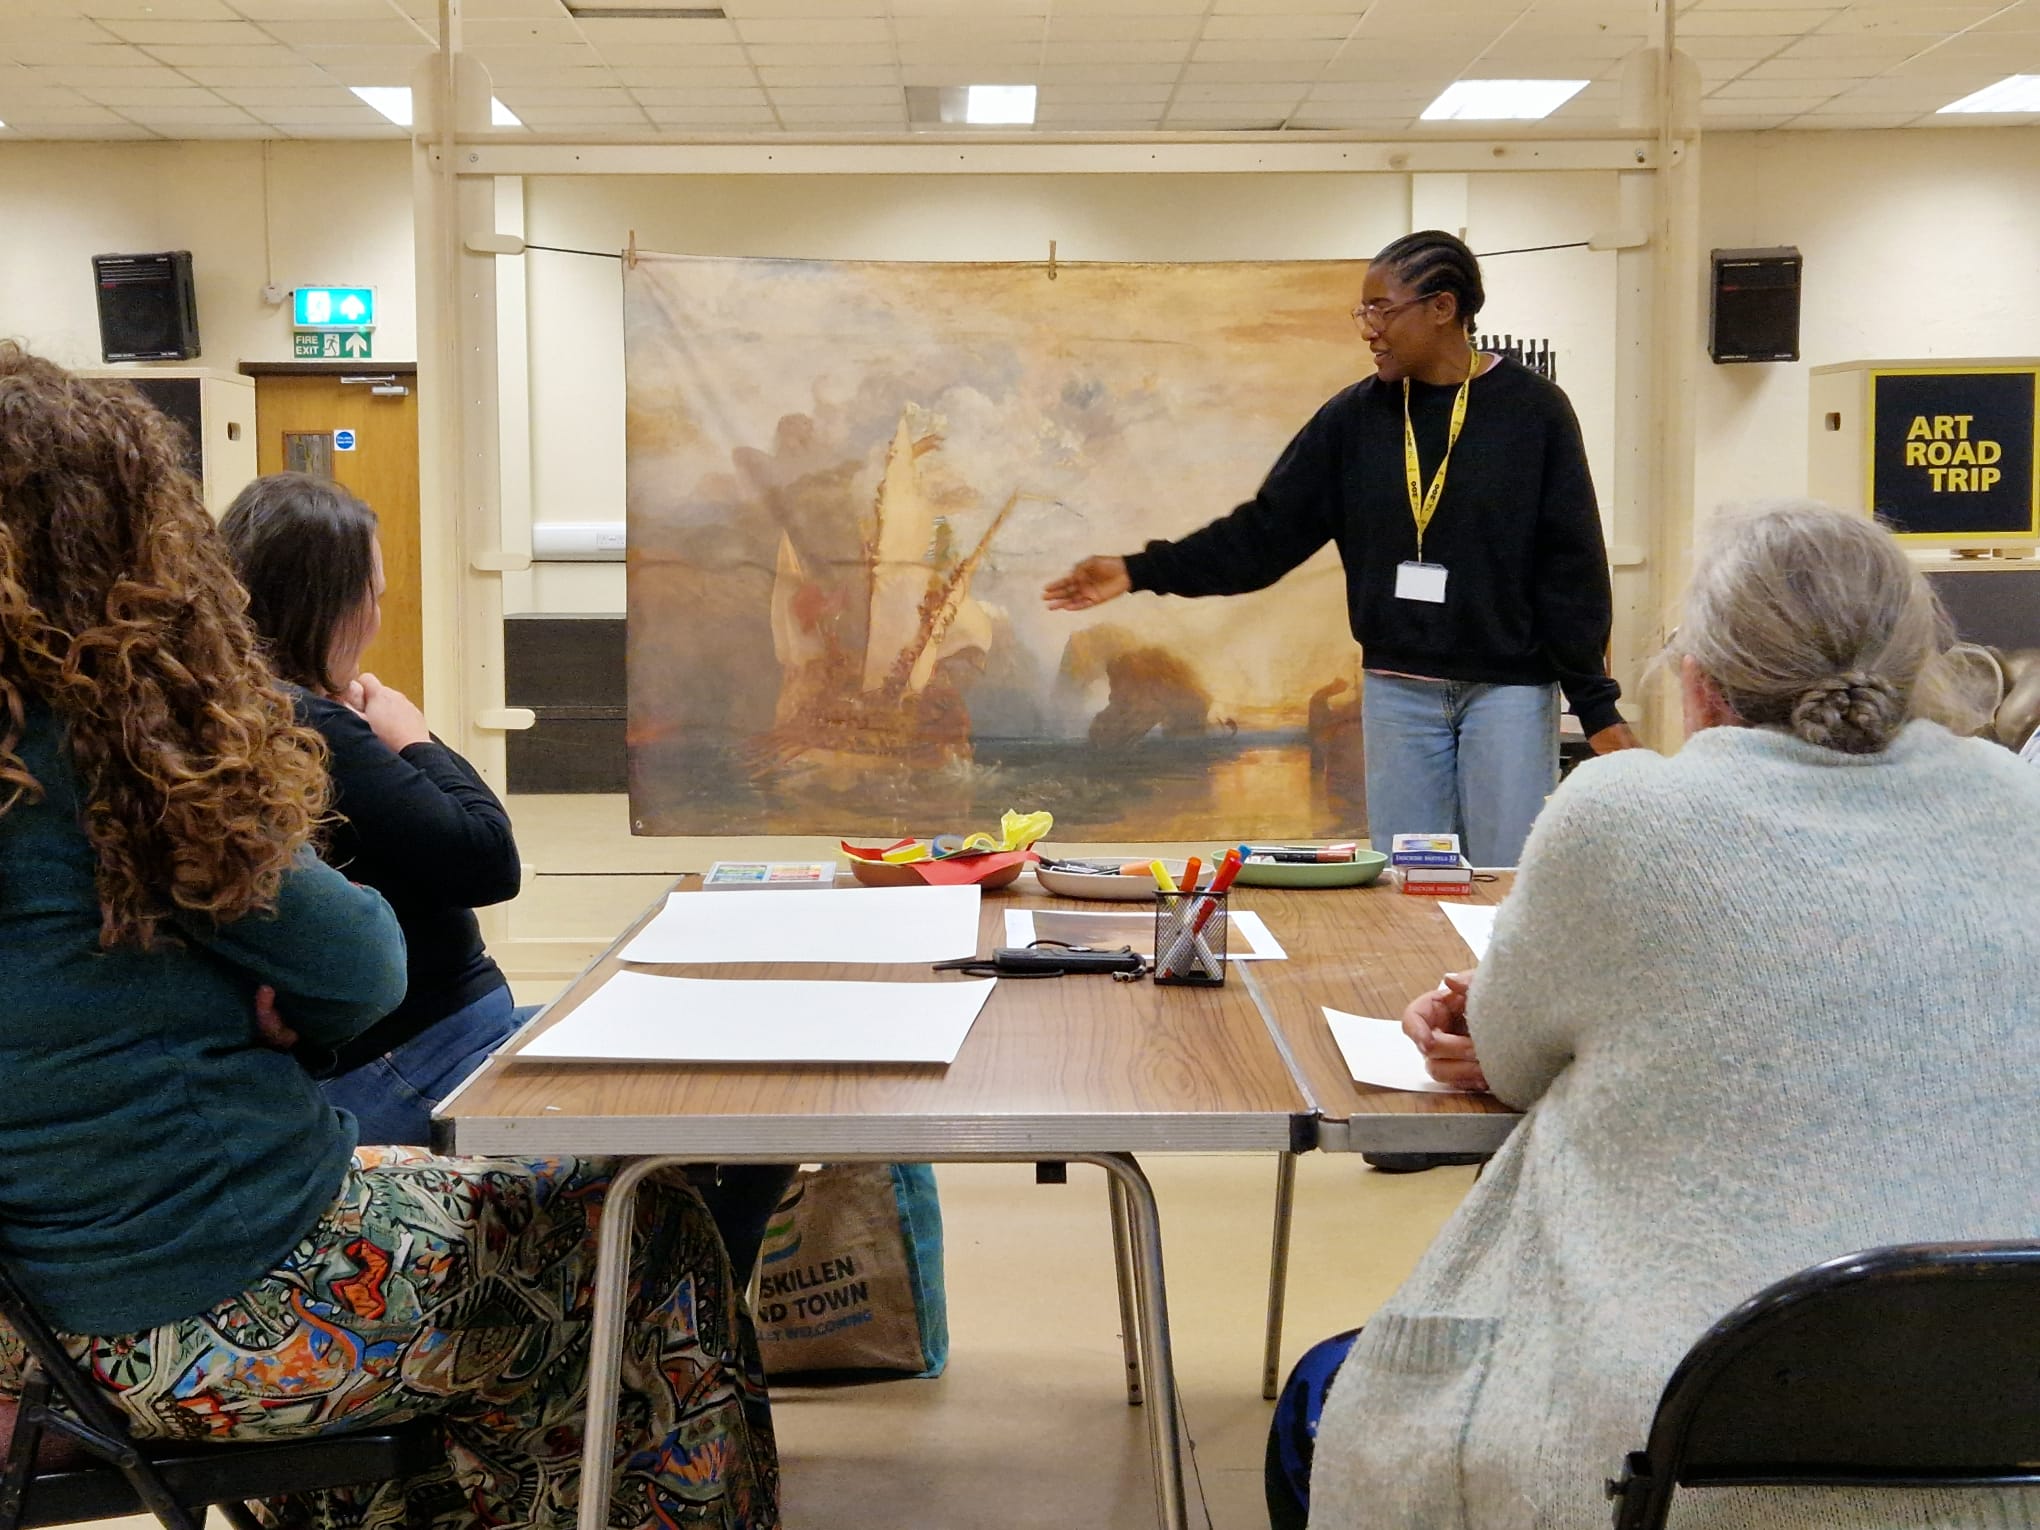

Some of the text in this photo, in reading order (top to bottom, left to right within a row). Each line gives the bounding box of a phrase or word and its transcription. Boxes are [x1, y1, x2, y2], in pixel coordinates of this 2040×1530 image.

[295, 335, 319, 344] FIRE
[295, 346, 319, 355] EXIT
[1907, 415, 1973, 440] ART
[1906, 440, 2002, 466] ROAD
[1928, 467, 2001, 492] TRIP
[793, 1281, 869, 1320] TOWN
